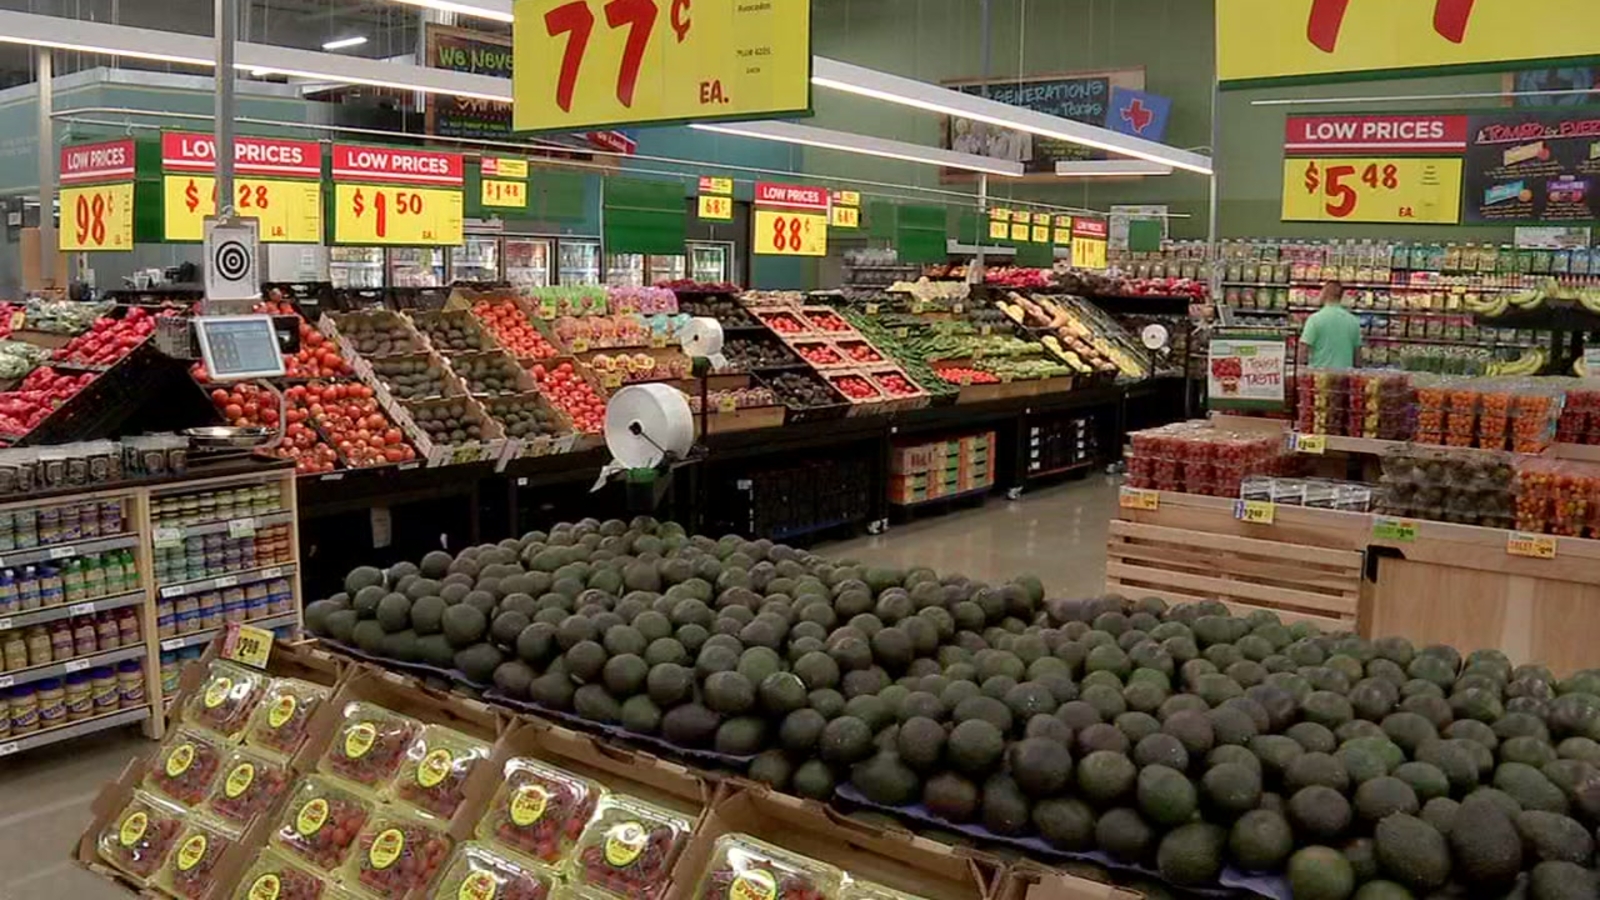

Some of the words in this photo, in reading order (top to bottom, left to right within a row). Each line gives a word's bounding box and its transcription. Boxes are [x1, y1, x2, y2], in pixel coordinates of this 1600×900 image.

[699, 79, 730, 104] EA.
[994, 81, 1104, 104] GENERATIONS
[1304, 122, 1357, 140] LOW
[1362, 121, 1444, 139] PRICES
[67, 150, 90, 171] LOW
[90, 147, 126, 168] PRICES
[234, 143, 303, 164] PRICES
[347, 151, 389, 170] LOW
[391, 154, 450, 175] PRICES
[763, 186, 788, 200] LOW
[787, 188, 820, 204] PRICES
